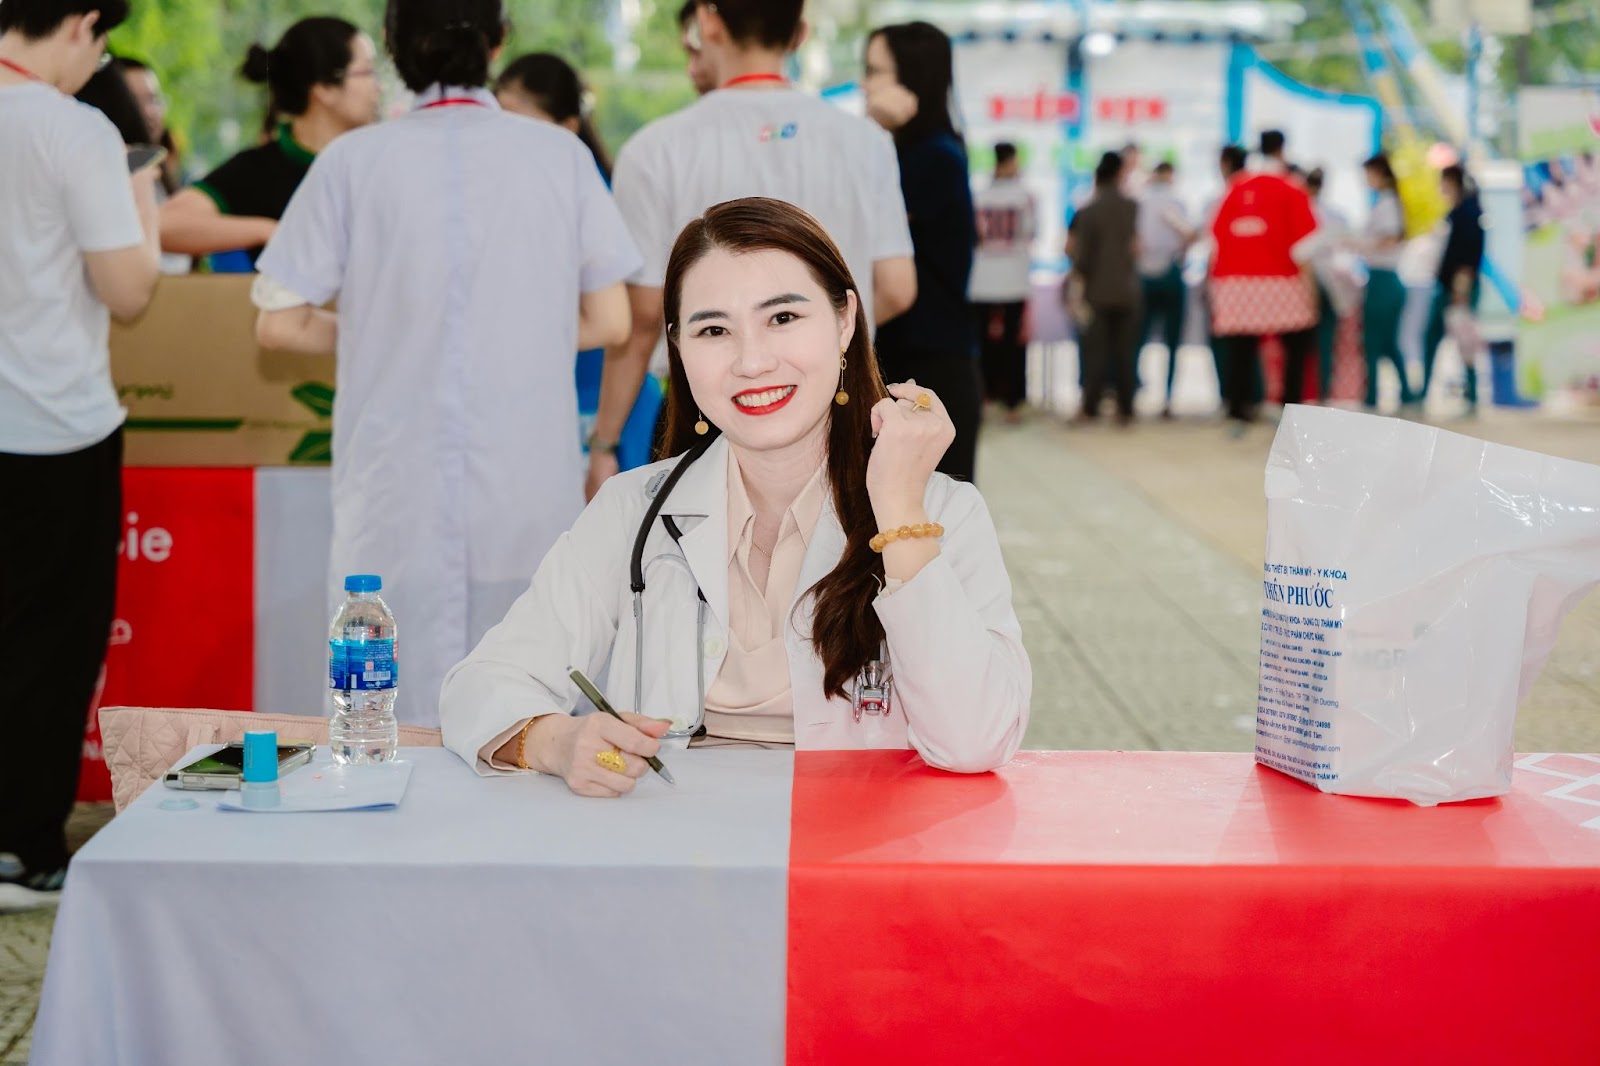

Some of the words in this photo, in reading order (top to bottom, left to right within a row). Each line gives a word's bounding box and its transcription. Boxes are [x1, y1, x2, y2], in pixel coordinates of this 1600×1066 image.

[118, 511, 174, 563] ie
[1317, 568, 1322, 577] Y
[1323, 568, 1348, 580] KHOA
[1287, 582, 1334, 609] PHƯỚC
